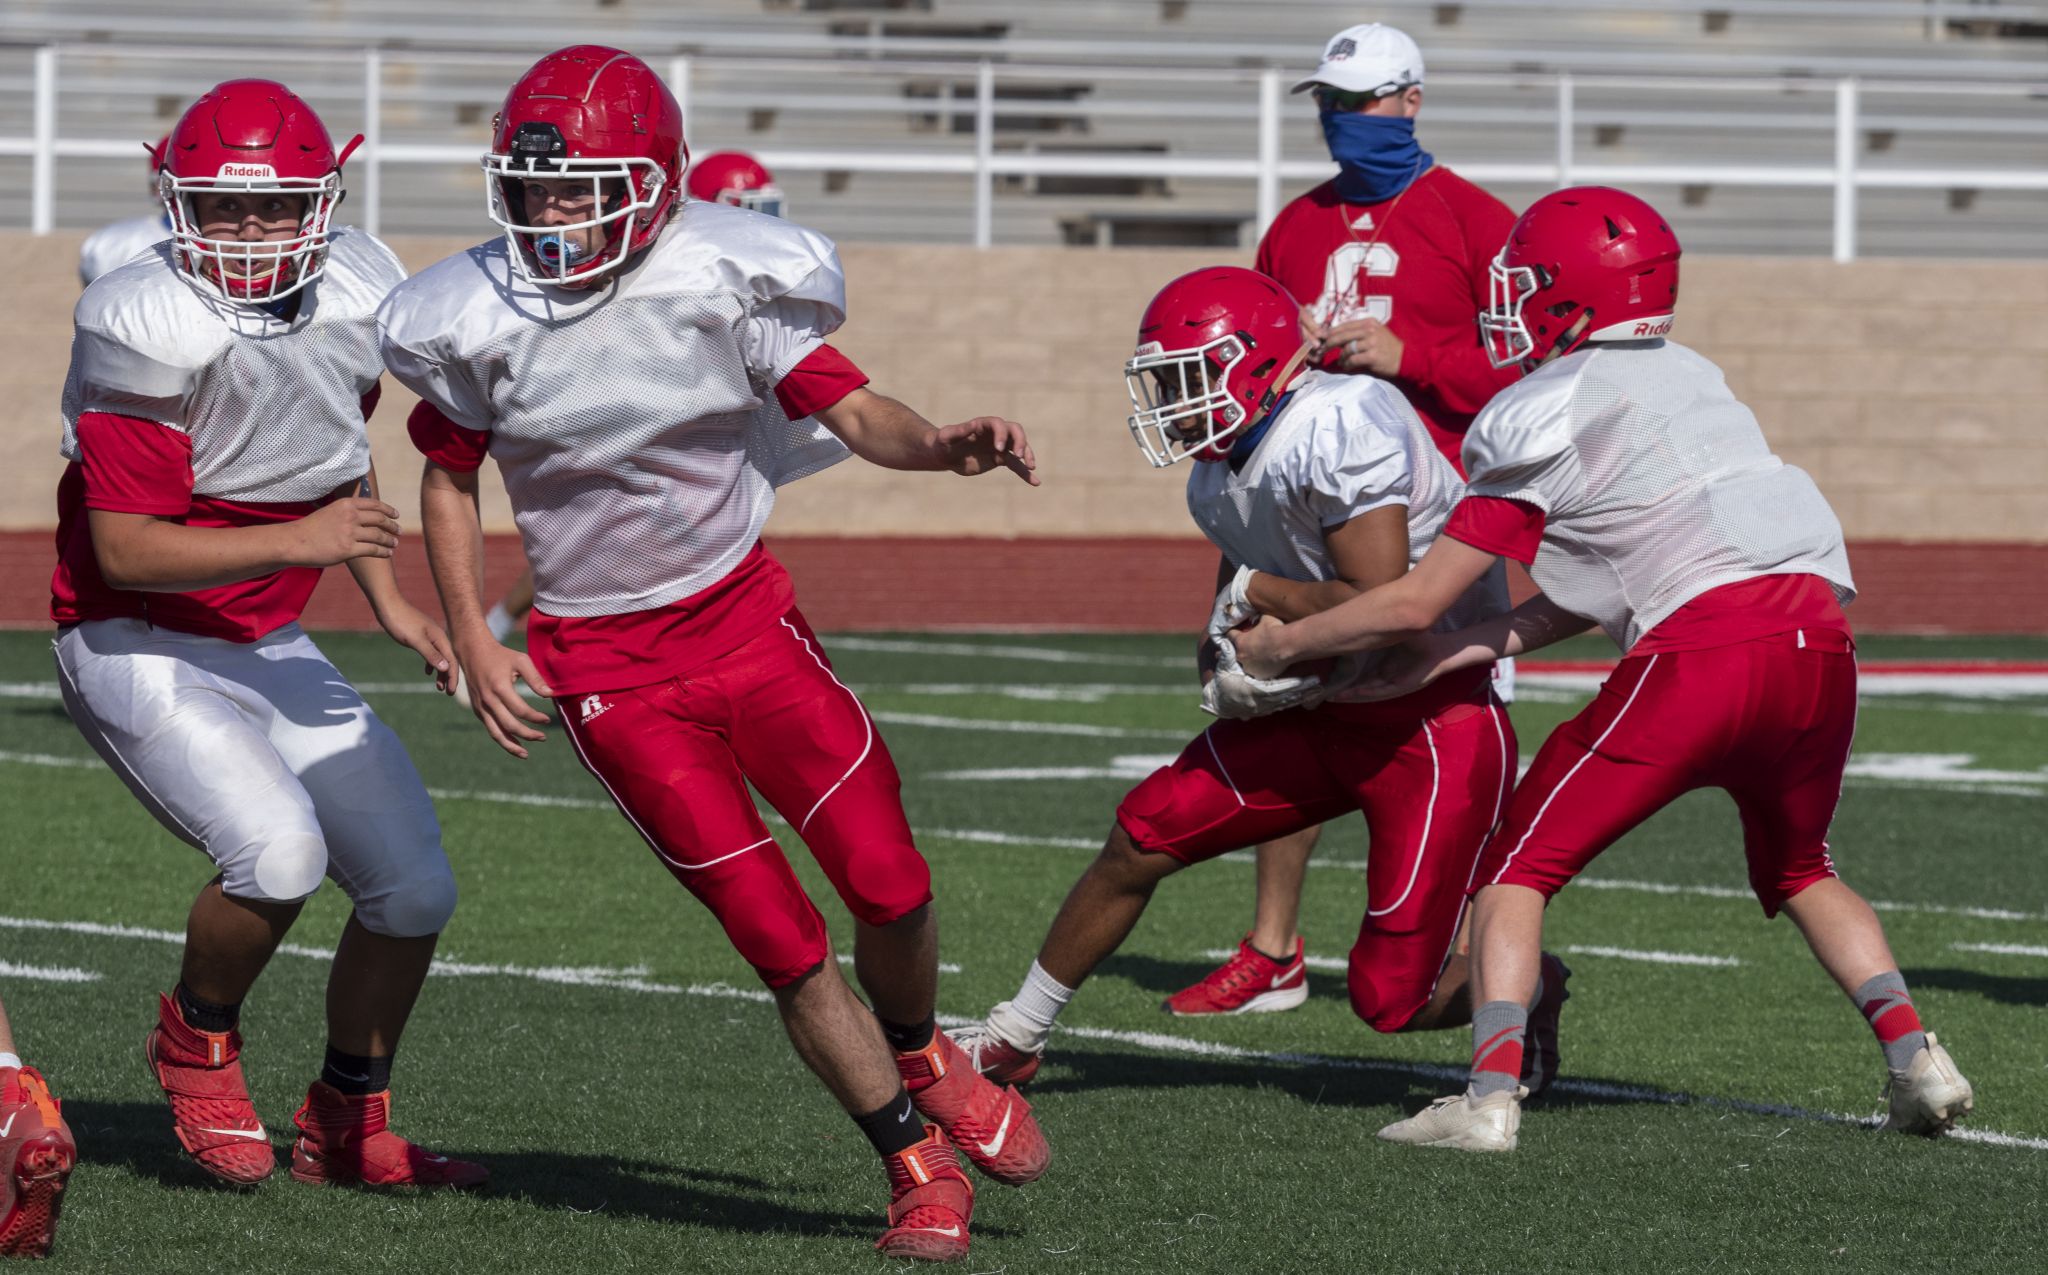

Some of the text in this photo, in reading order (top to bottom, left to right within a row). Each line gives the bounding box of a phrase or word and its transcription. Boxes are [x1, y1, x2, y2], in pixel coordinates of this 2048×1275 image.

[224, 165, 270, 177] Riddell
[1323, 242, 1400, 326] C
[581, 702, 615, 726] RUSSELL
